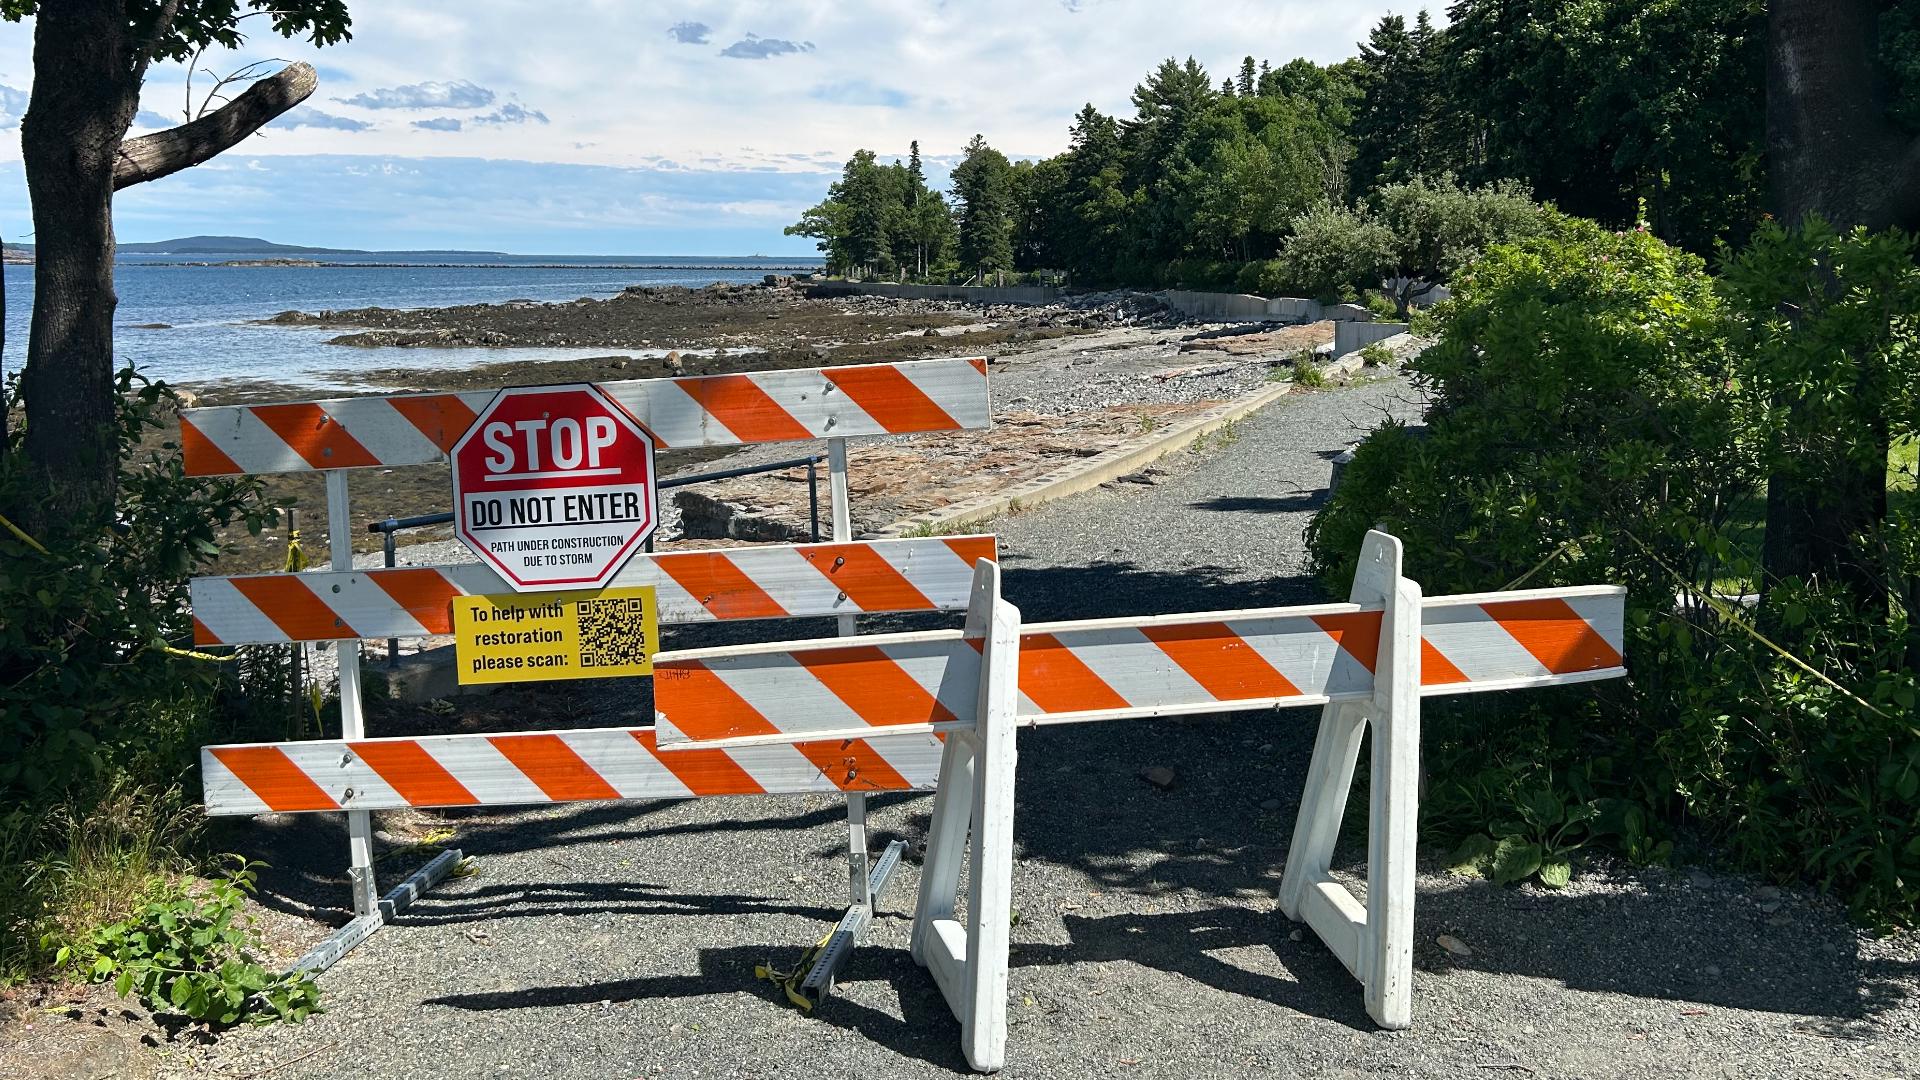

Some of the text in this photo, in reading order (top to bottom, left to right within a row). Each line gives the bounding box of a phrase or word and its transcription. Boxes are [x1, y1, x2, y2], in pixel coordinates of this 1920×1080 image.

[483, 416, 617, 473] STOP
[472, 492, 639, 526] DO NOT ENTER
[491, 535, 624, 552] PATH UNDER CONSTRUCTION
[524, 553, 593, 567] DUE TO STORM
[470, 602, 564, 622] To help with
[475, 628, 563, 646] restoration
[473, 653, 569, 673] please scan:
